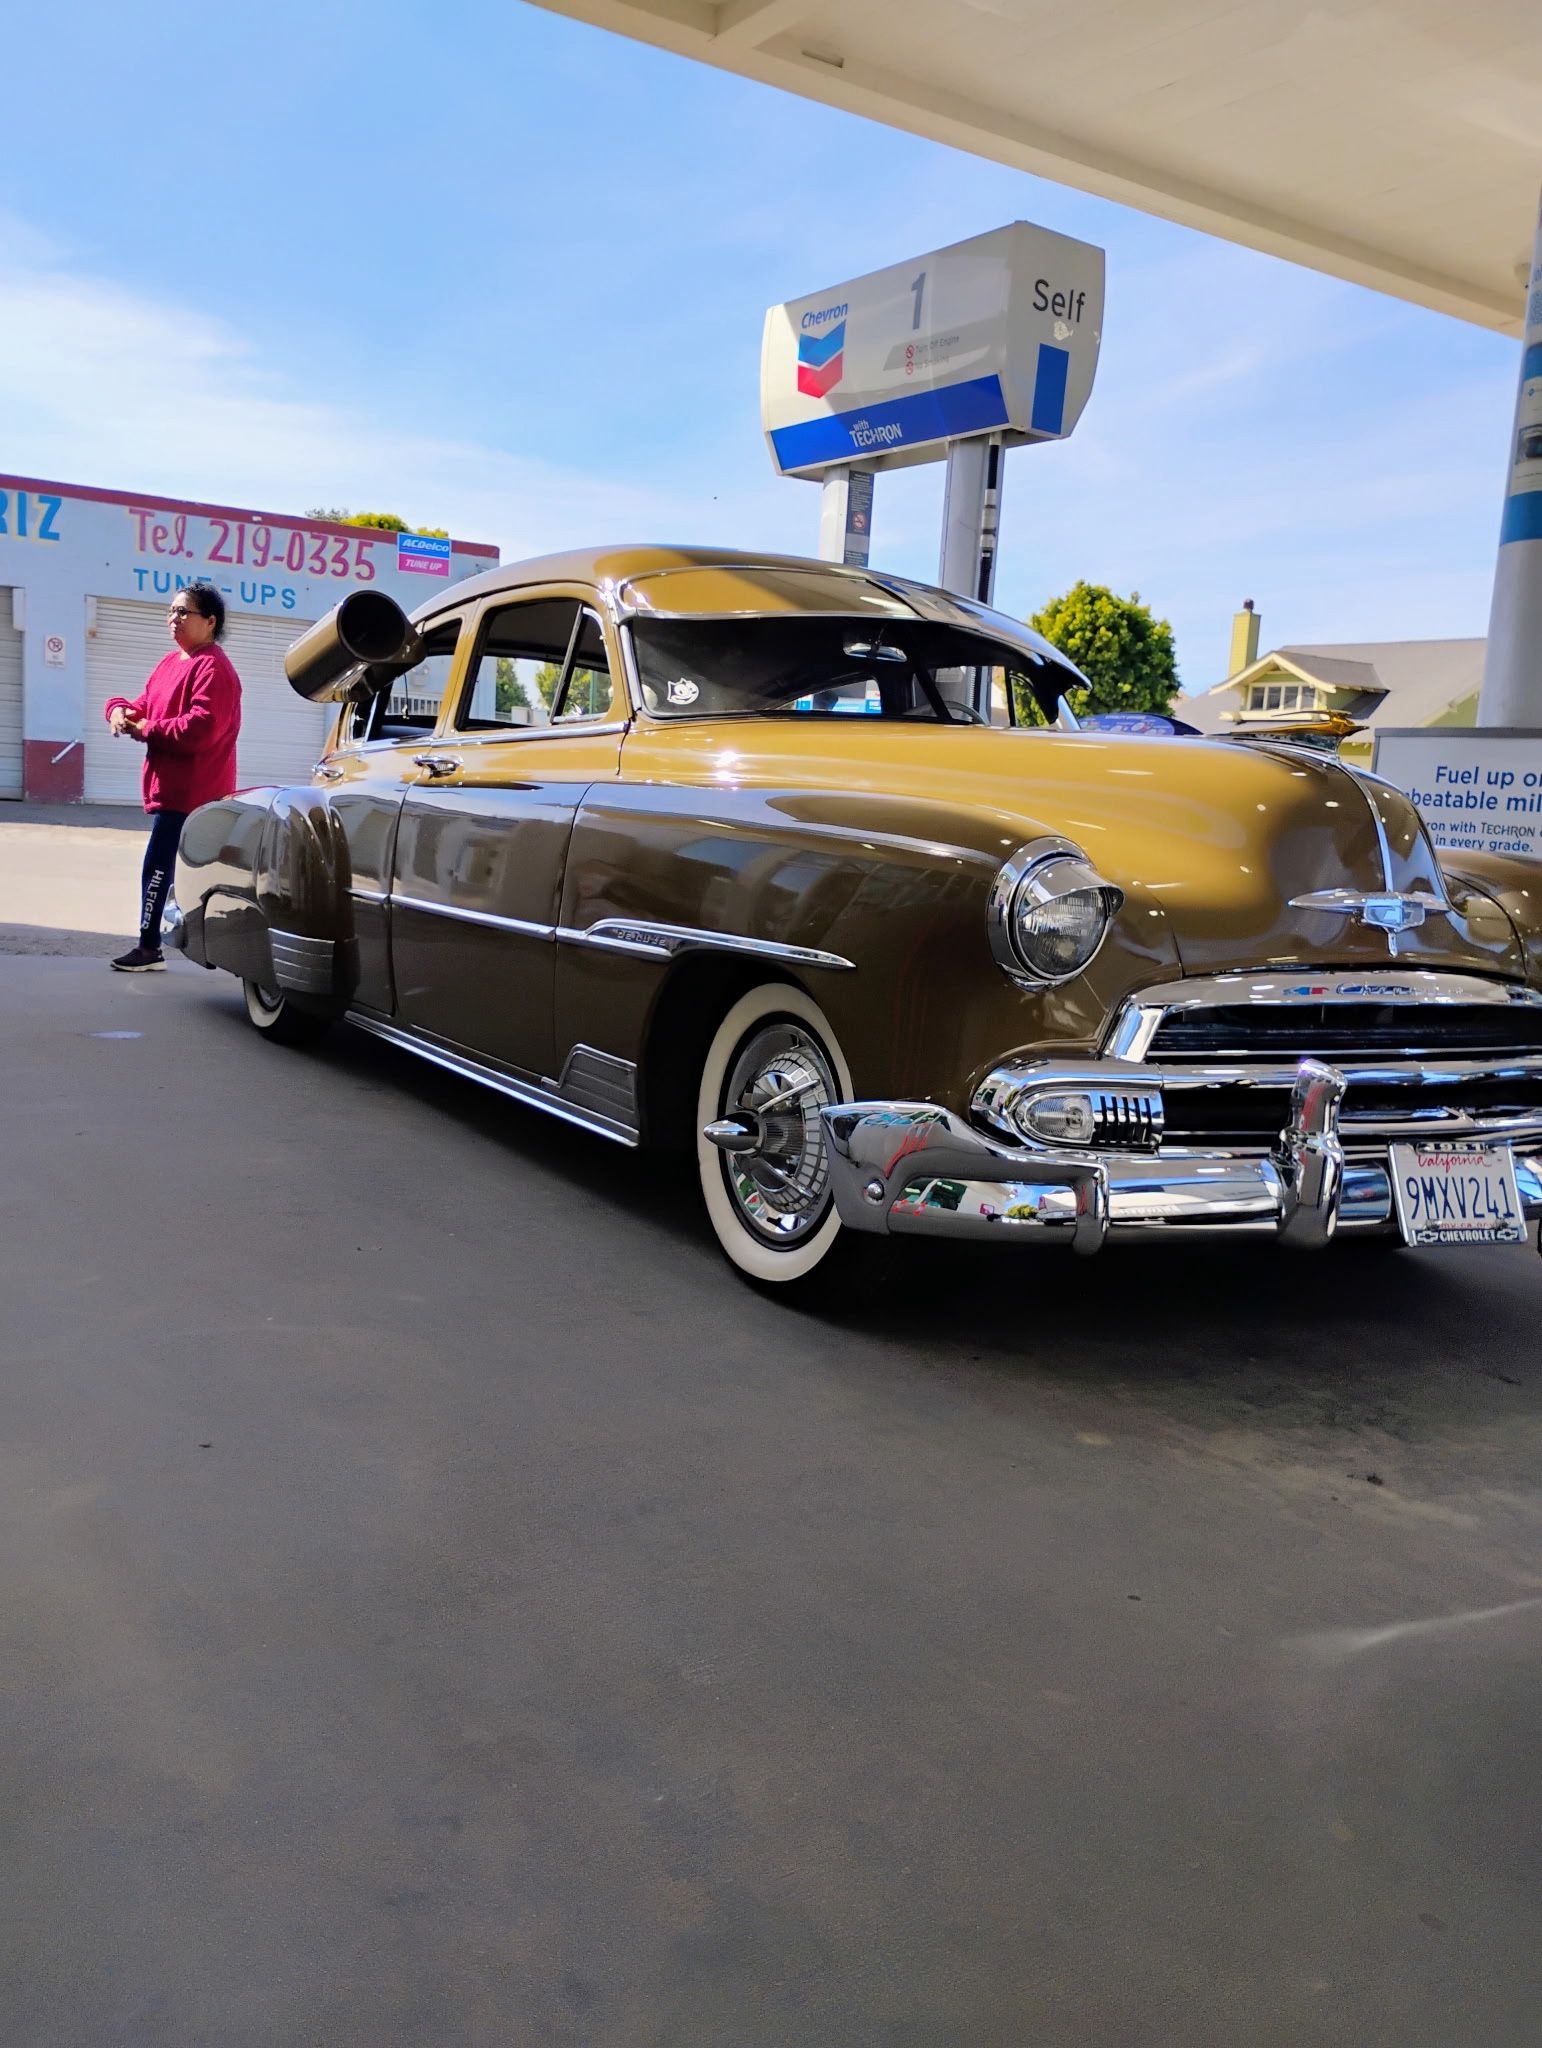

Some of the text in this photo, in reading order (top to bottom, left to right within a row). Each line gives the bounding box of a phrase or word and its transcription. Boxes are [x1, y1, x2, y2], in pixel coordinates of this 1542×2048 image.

[911, 272, 926, 330] 1
[1033, 279, 1086, 323] Self
[801, 303, 849, 329] Chevron
[849, 423, 903, 448] TECHRON
[853, 419, 870, 431] with
[128, 508, 376, 582] Tel. 219-0335
[402, 538, 449, 552] ACDelco
[405, 558, 443, 571] TUNE UP
[1435, 766, 1480, 785] Fuel
[1486, 771, 1515, 790] up
[1449, 821, 1477, 834] with
[1481, 822, 1536, 839] TECHRON
[1435, 834, 1534, 853] in every grade.
[140, 869, 165, 930] HILFIGER
[1406, 1176, 1515, 1220] 9MXV241
[1439, 1229, 1497, 1242] CHEVROLET
